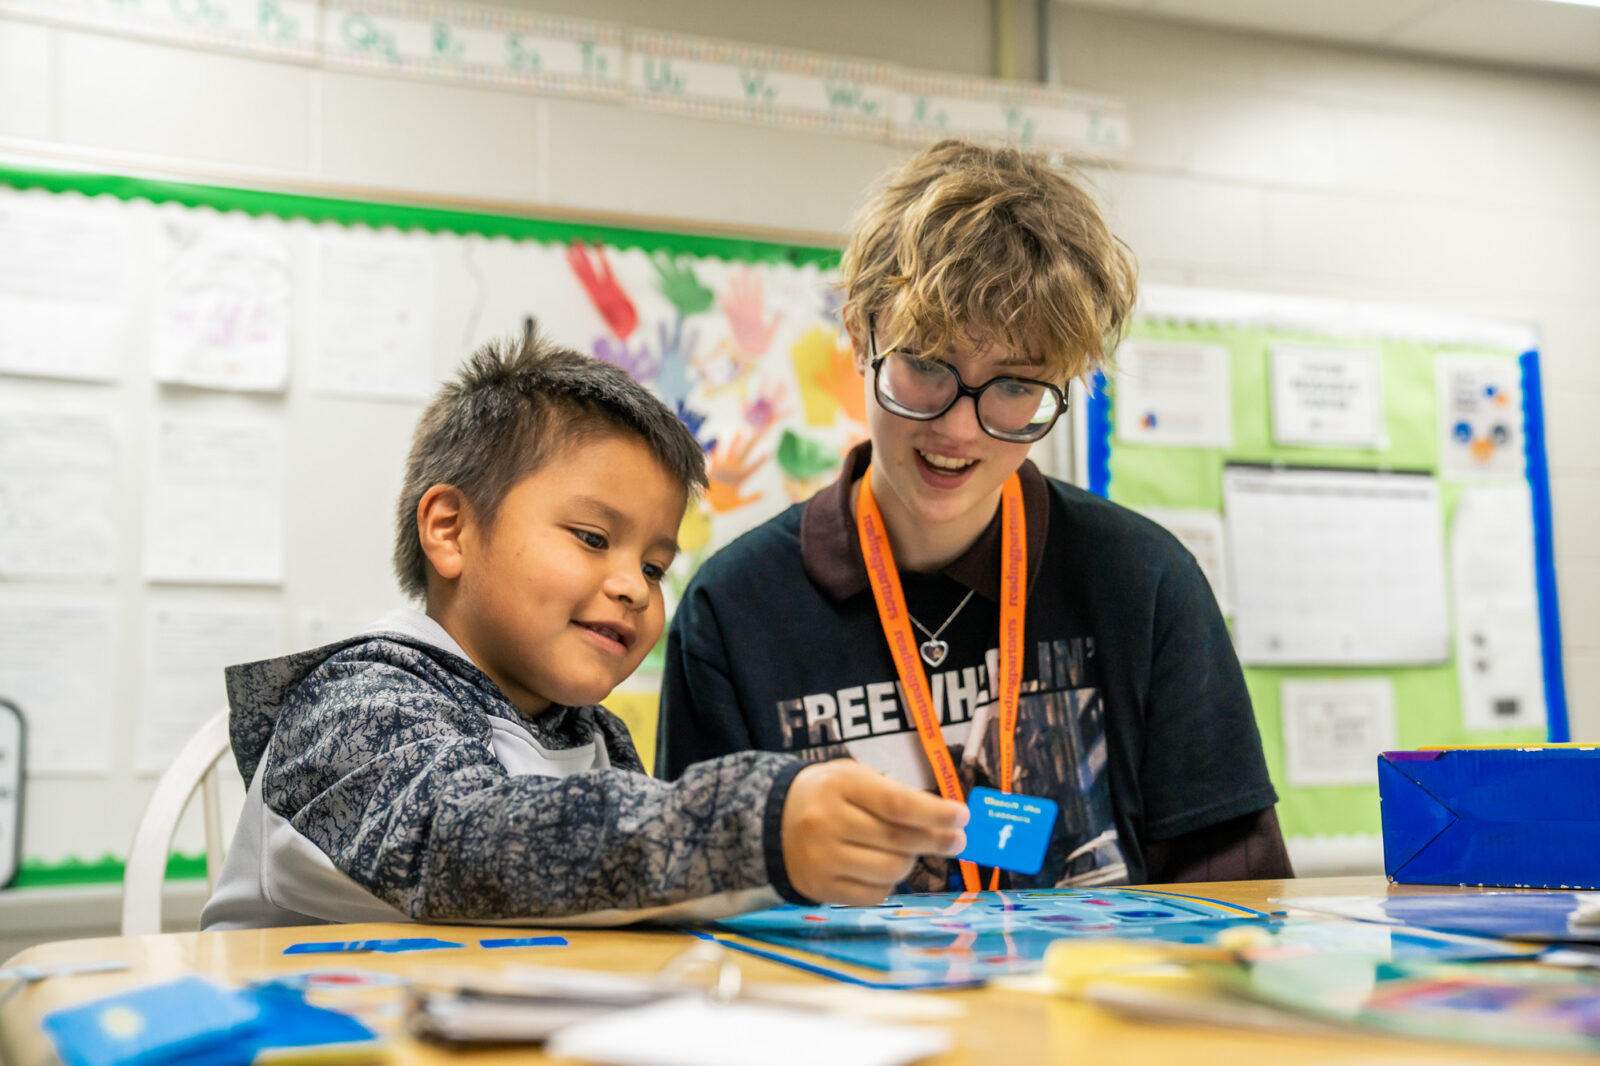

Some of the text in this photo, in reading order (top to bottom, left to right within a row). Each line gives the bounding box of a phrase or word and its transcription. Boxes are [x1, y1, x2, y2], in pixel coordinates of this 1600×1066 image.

[863, 513, 898, 621] readingpartners
[893, 630, 935, 740] readingpartners
[1005, 618, 1019, 732] readingpartners
